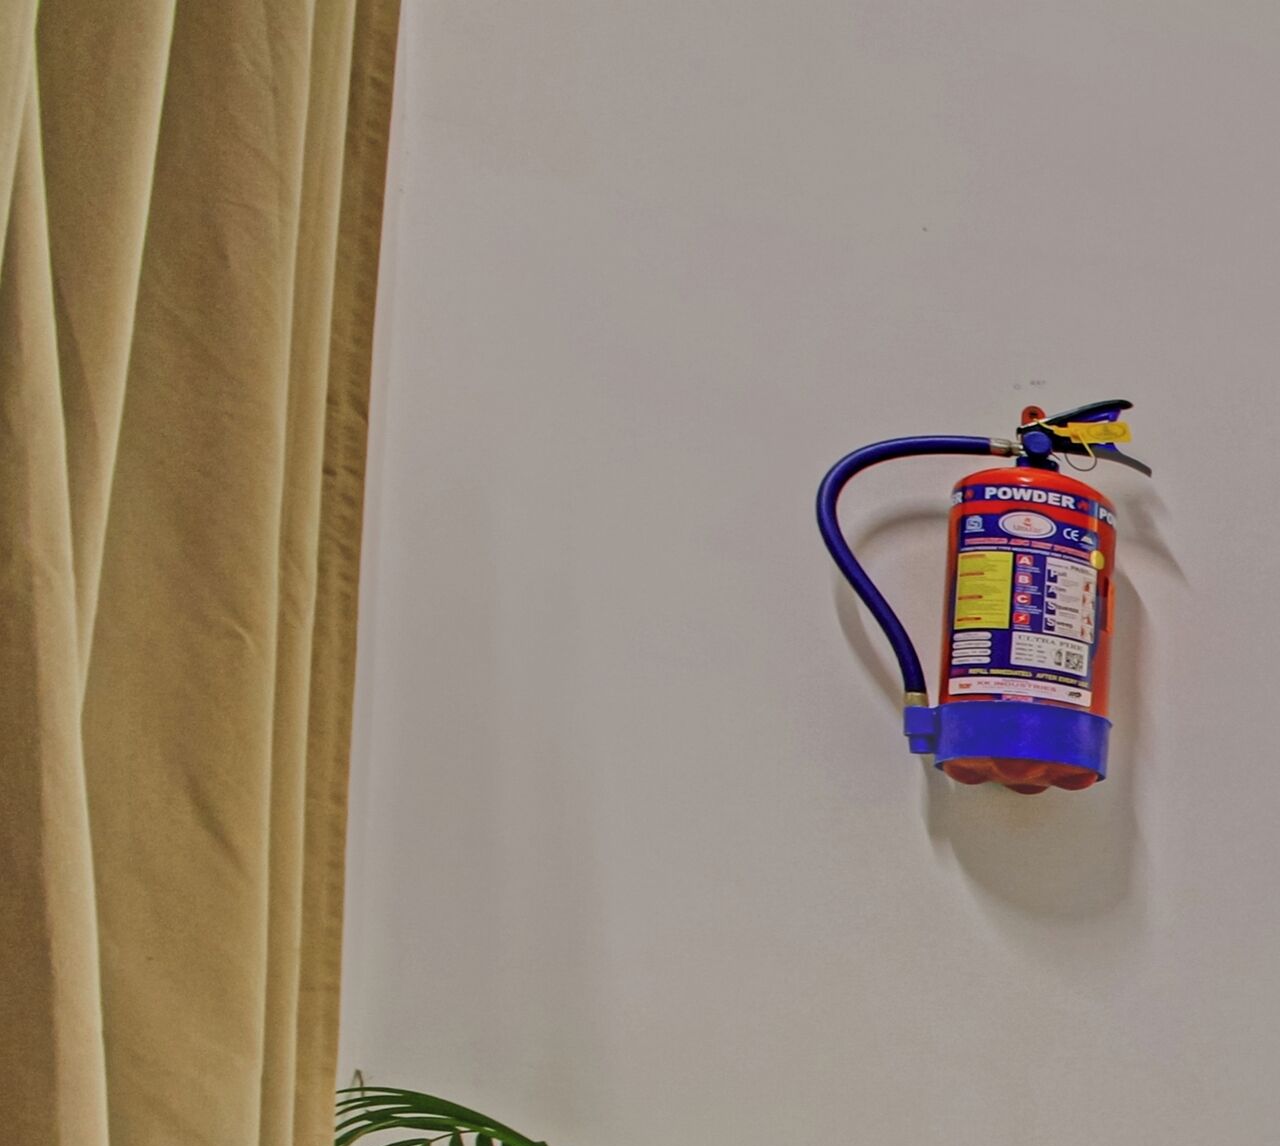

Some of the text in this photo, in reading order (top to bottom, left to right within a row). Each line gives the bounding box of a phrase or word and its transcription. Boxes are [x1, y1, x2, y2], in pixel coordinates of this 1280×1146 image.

[984, 486, 1076, 510] POWDER
[1062, 527, 1080, 542] CE
[1019, 555, 1032, 565] A
[1018, 574, 1030, 584] B
[1016, 594, 1029, 604] C
